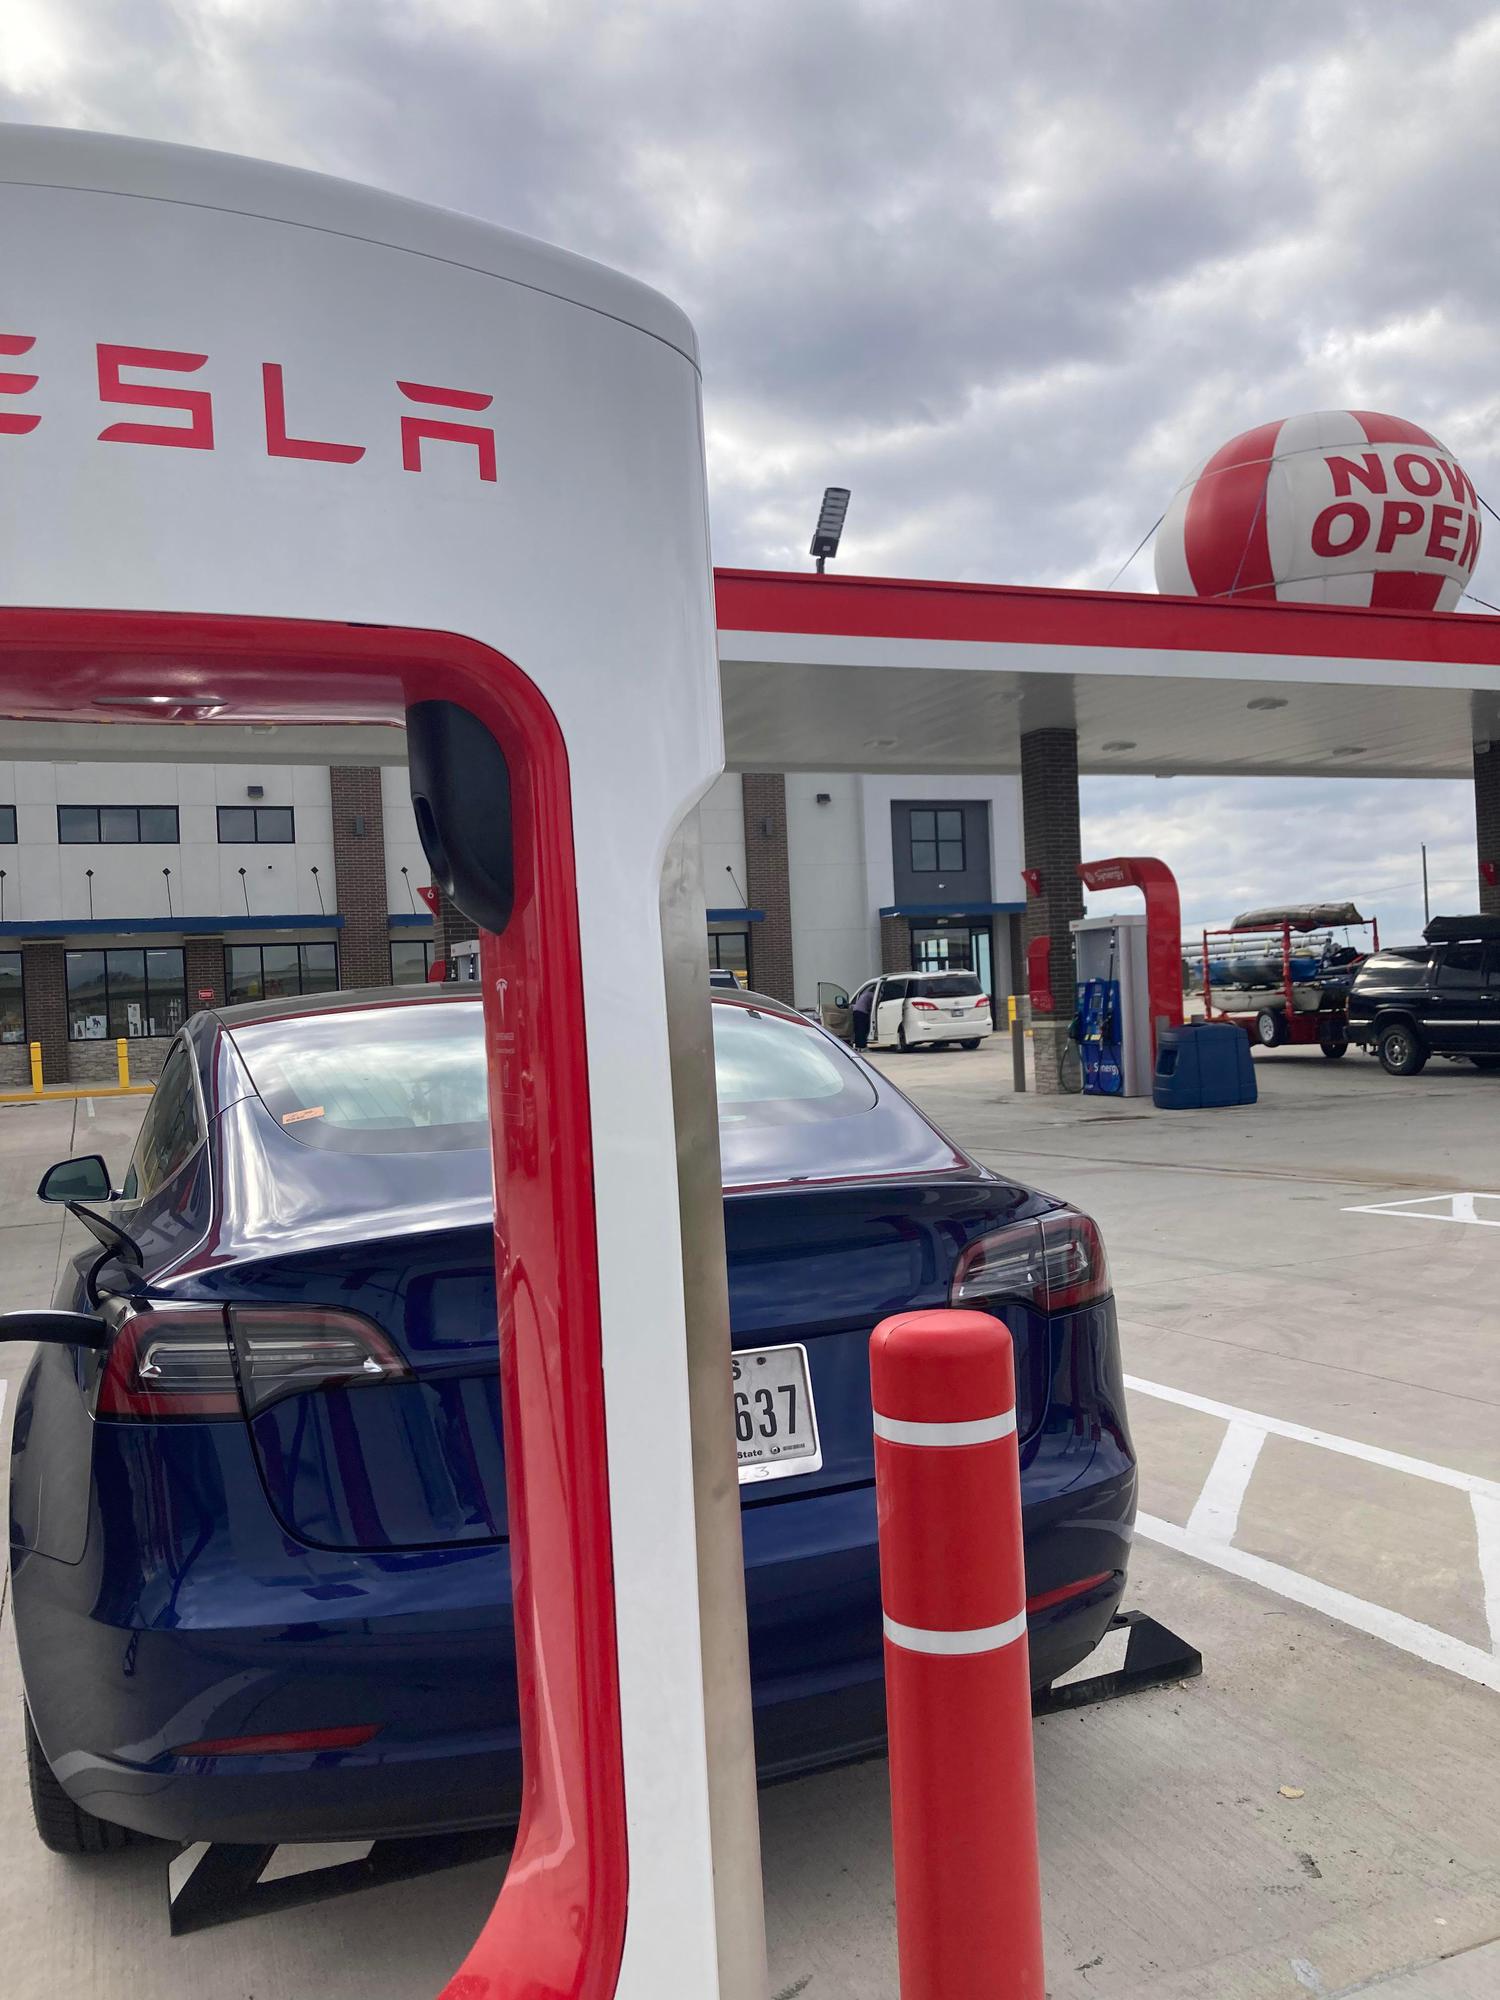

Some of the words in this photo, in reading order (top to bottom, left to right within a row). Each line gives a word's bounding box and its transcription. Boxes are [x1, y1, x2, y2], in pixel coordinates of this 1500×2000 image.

[1324, 453, 1478, 511] NOW
[1311, 501, 1482, 573] OPEN
[427, 889, 434, 898] 6
[1093, 1062, 1119, 1076] Snergy
